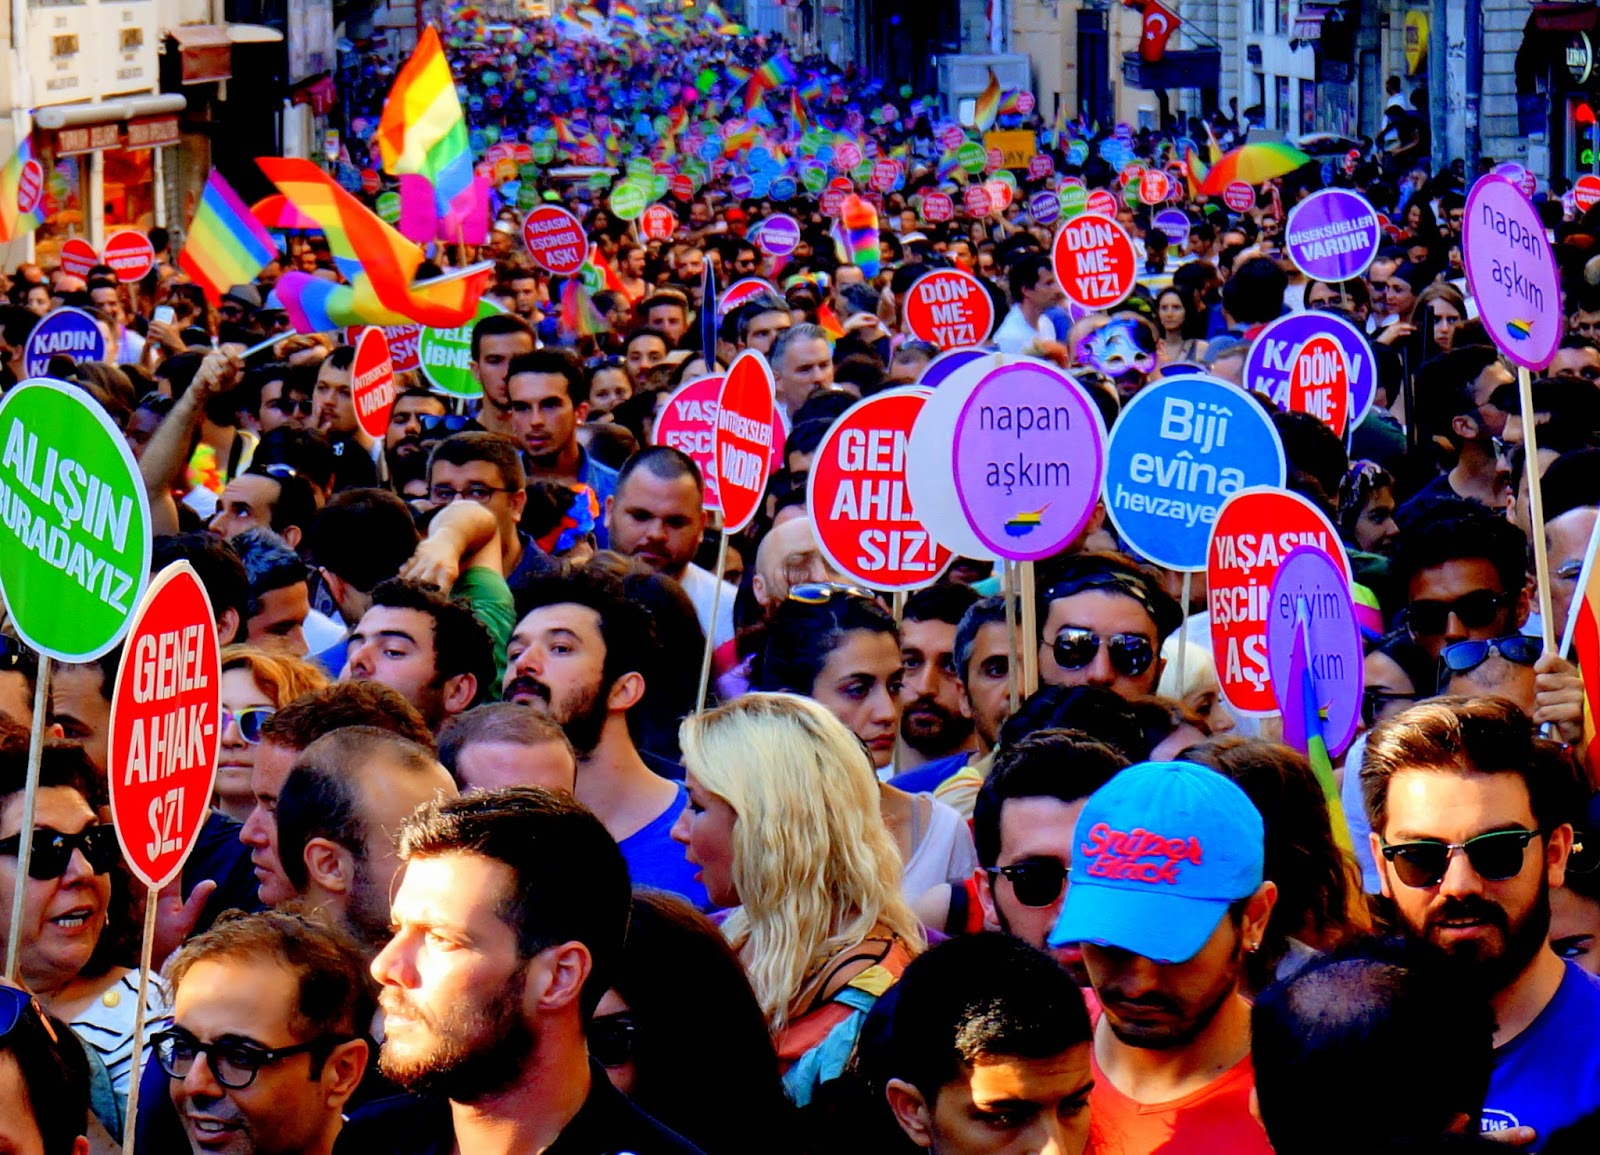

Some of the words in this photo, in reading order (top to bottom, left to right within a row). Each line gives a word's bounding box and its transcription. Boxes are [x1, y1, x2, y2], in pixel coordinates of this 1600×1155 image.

[527, 216, 572, 235] YAŞASIN
[1066, 221, 1120, 251] DÖN-
[1482, 203, 1542, 261] napan
[545, 247, 580, 267] AŞK!
[1076, 248, 1118, 275] ME-
[1300, 231, 1370, 262] VARDIR
[919, 277, 976, 305] DÖN-
[1075, 273, 1120, 300] YİZ!
[1492, 259, 1543, 313] aşkım
[931, 301, 973, 325] ME-
[34, 330, 96, 355] KADIN
[932, 323, 976, 347] YİZ!
[1299, 346, 1342, 387] DÖN-
[980, 405, 1070, 439] napan
[1159, 396, 1234, 454] Bijî
[2, 416, 133, 554] ALIŞIN
[986, 452, 1070, 496] aşkım
[1129, 450, 1246, 499] evîna
[1114, 483, 1217, 529] hevzaye
[0, 477, 134, 616] URADAYIZ
[856, 529, 937, 572] SIZ!
[1280, 584, 1341, 630] eyyim
[133, 624, 209, 705] GENEL
